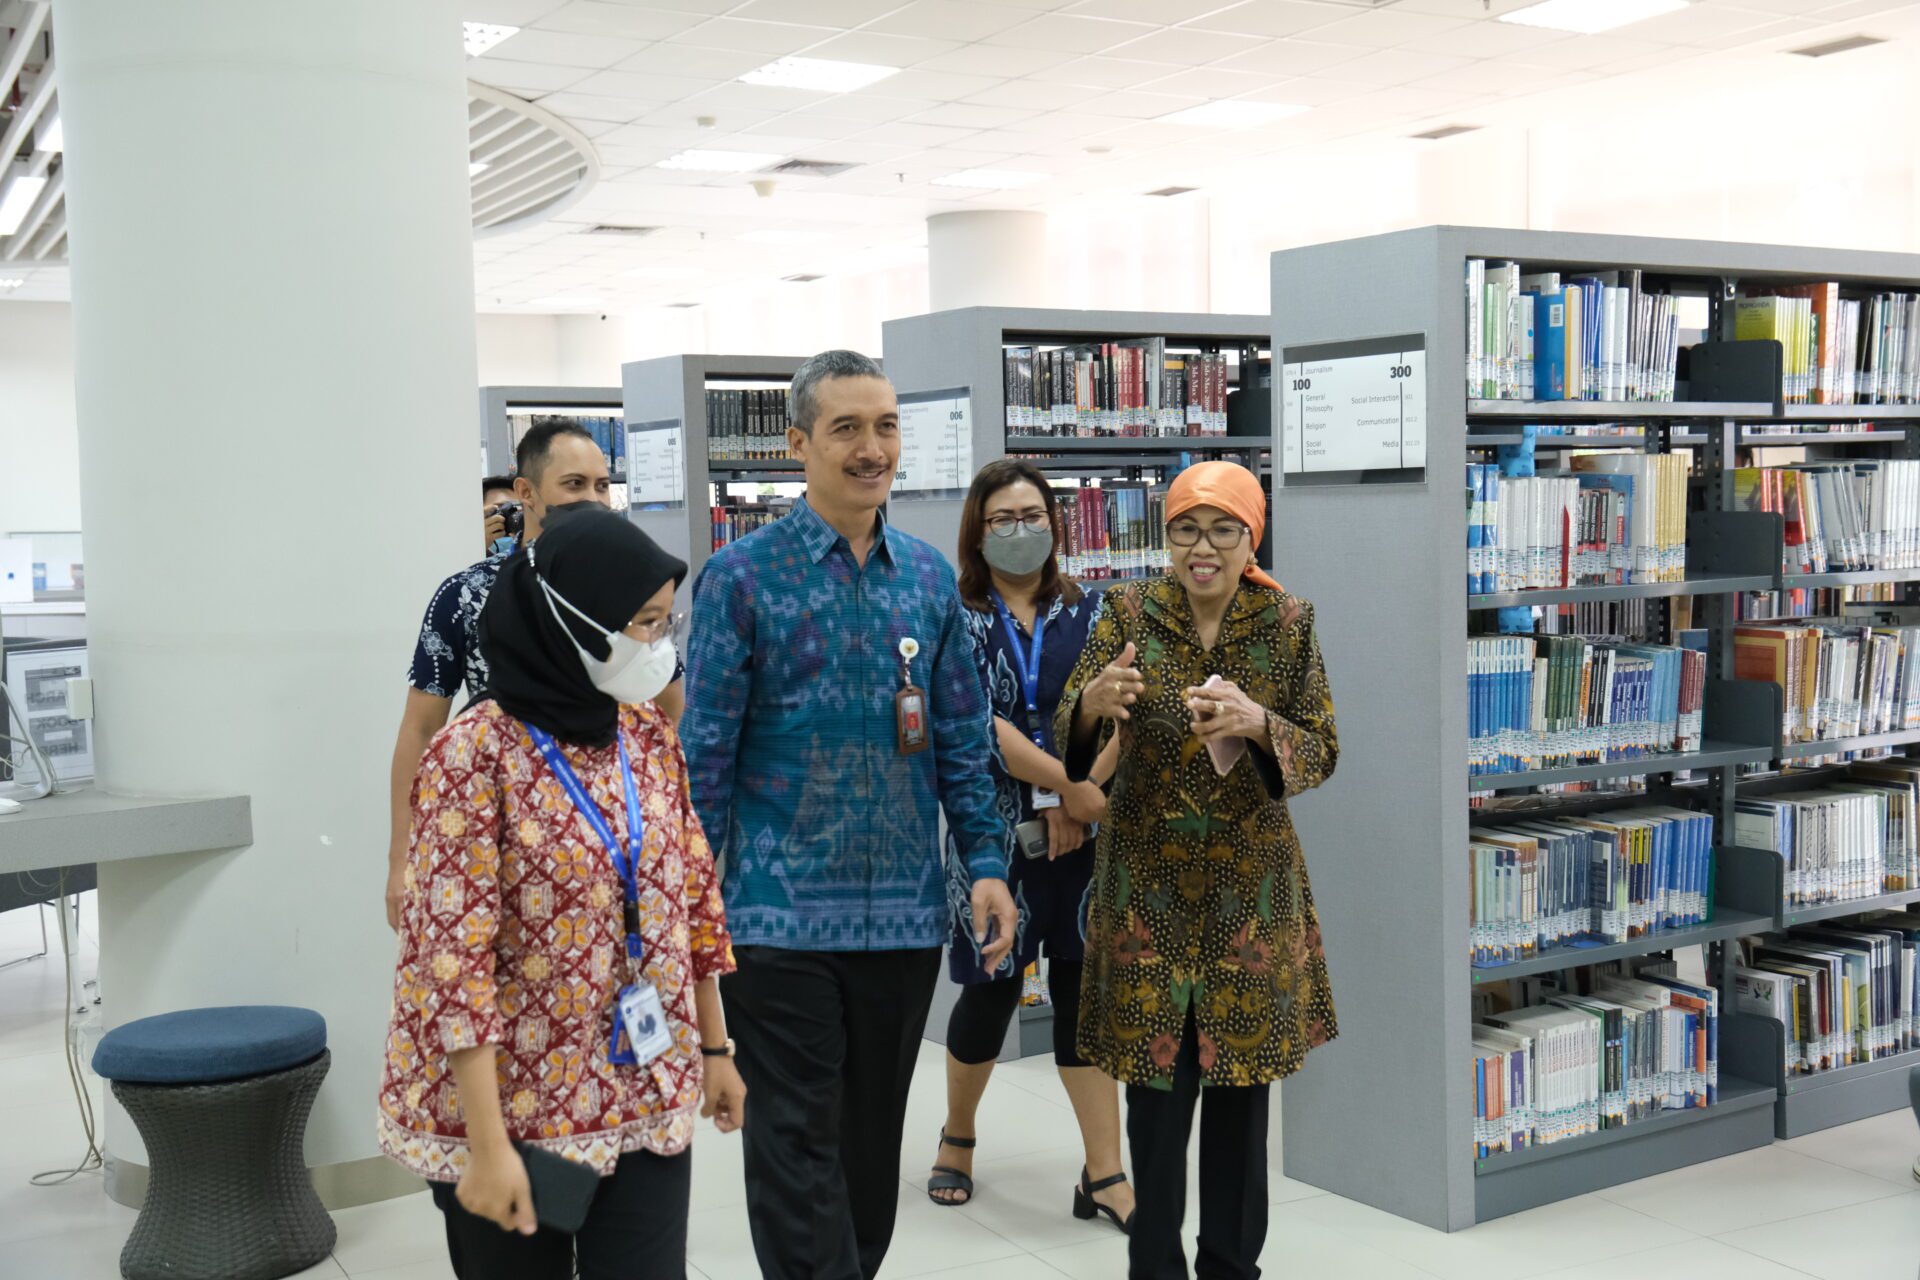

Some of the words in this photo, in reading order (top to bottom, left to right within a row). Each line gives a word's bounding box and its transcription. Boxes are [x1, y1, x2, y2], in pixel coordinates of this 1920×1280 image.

[1305, 366, 1333, 375] Journalism
[1390, 365, 1412, 378] 300
[1292, 378, 1311, 391] 100
[1305, 393, 1326, 402] General
[1351, 397, 1368, 405] Social
[1369, 394, 1399, 403] Interaction
[1305, 404, 1334, 413] Philosophy
[949, 411, 964, 421] 006
[1357, 417, 1399, 427] Communication
[1305, 423, 1327, 431] Religion
[1306, 440, 1322, 448] Social
[895, 471, 907, 480] 005
